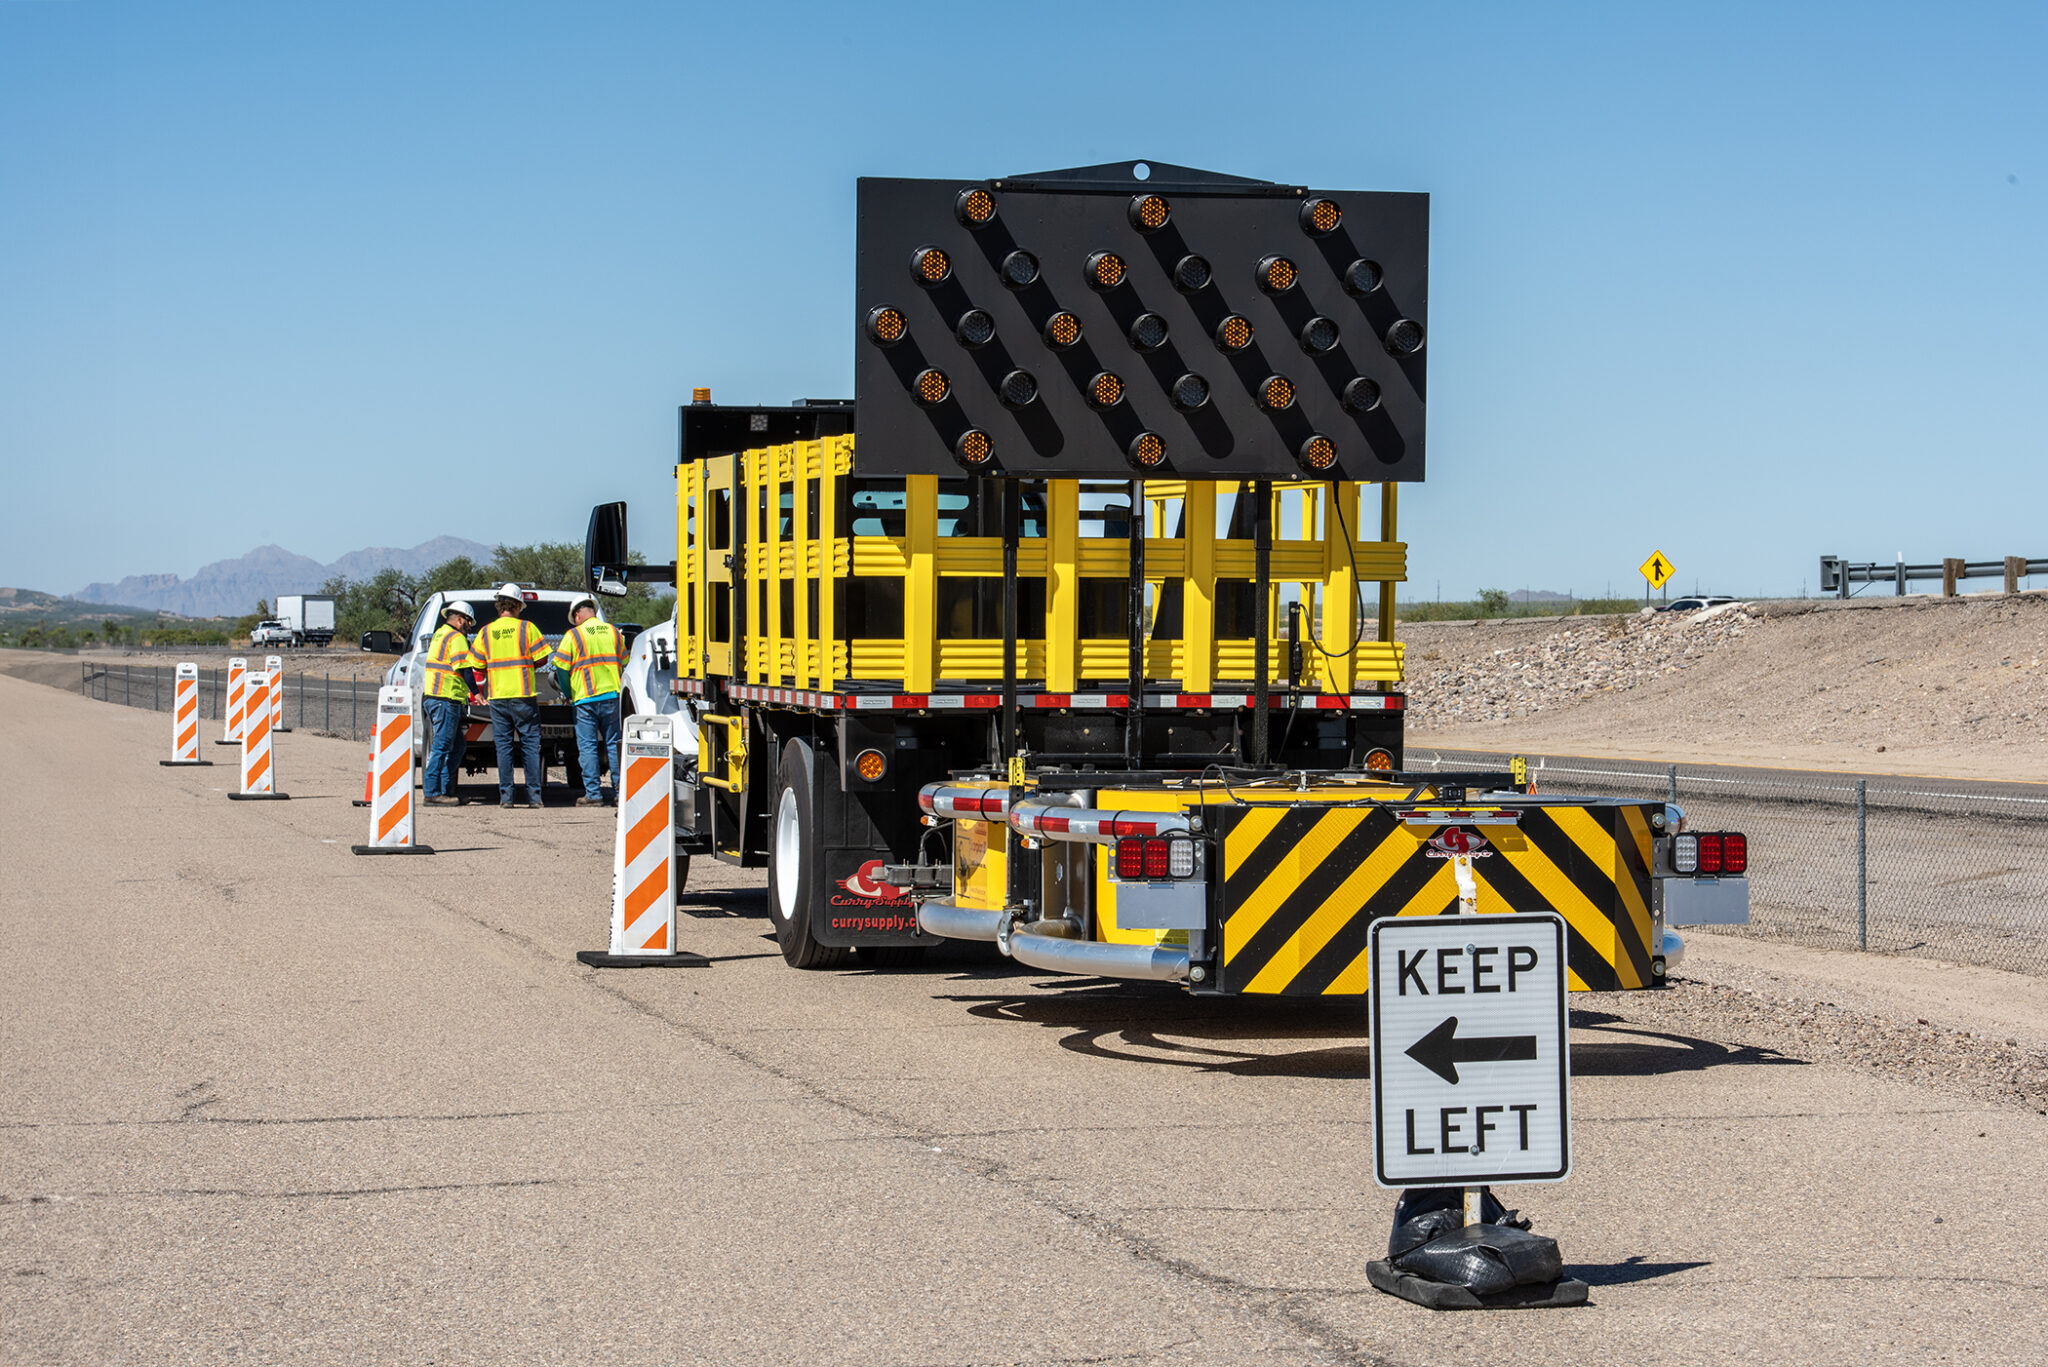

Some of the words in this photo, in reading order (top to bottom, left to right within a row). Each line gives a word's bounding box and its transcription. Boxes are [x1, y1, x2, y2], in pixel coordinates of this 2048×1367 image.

[831, 895, 873, 909] Curry
[832, 915, 917, 931] currysupply.c
[1398, 946, 1538, 996] KEEP
[1406, 1104, 1537, 1155] LEFT
